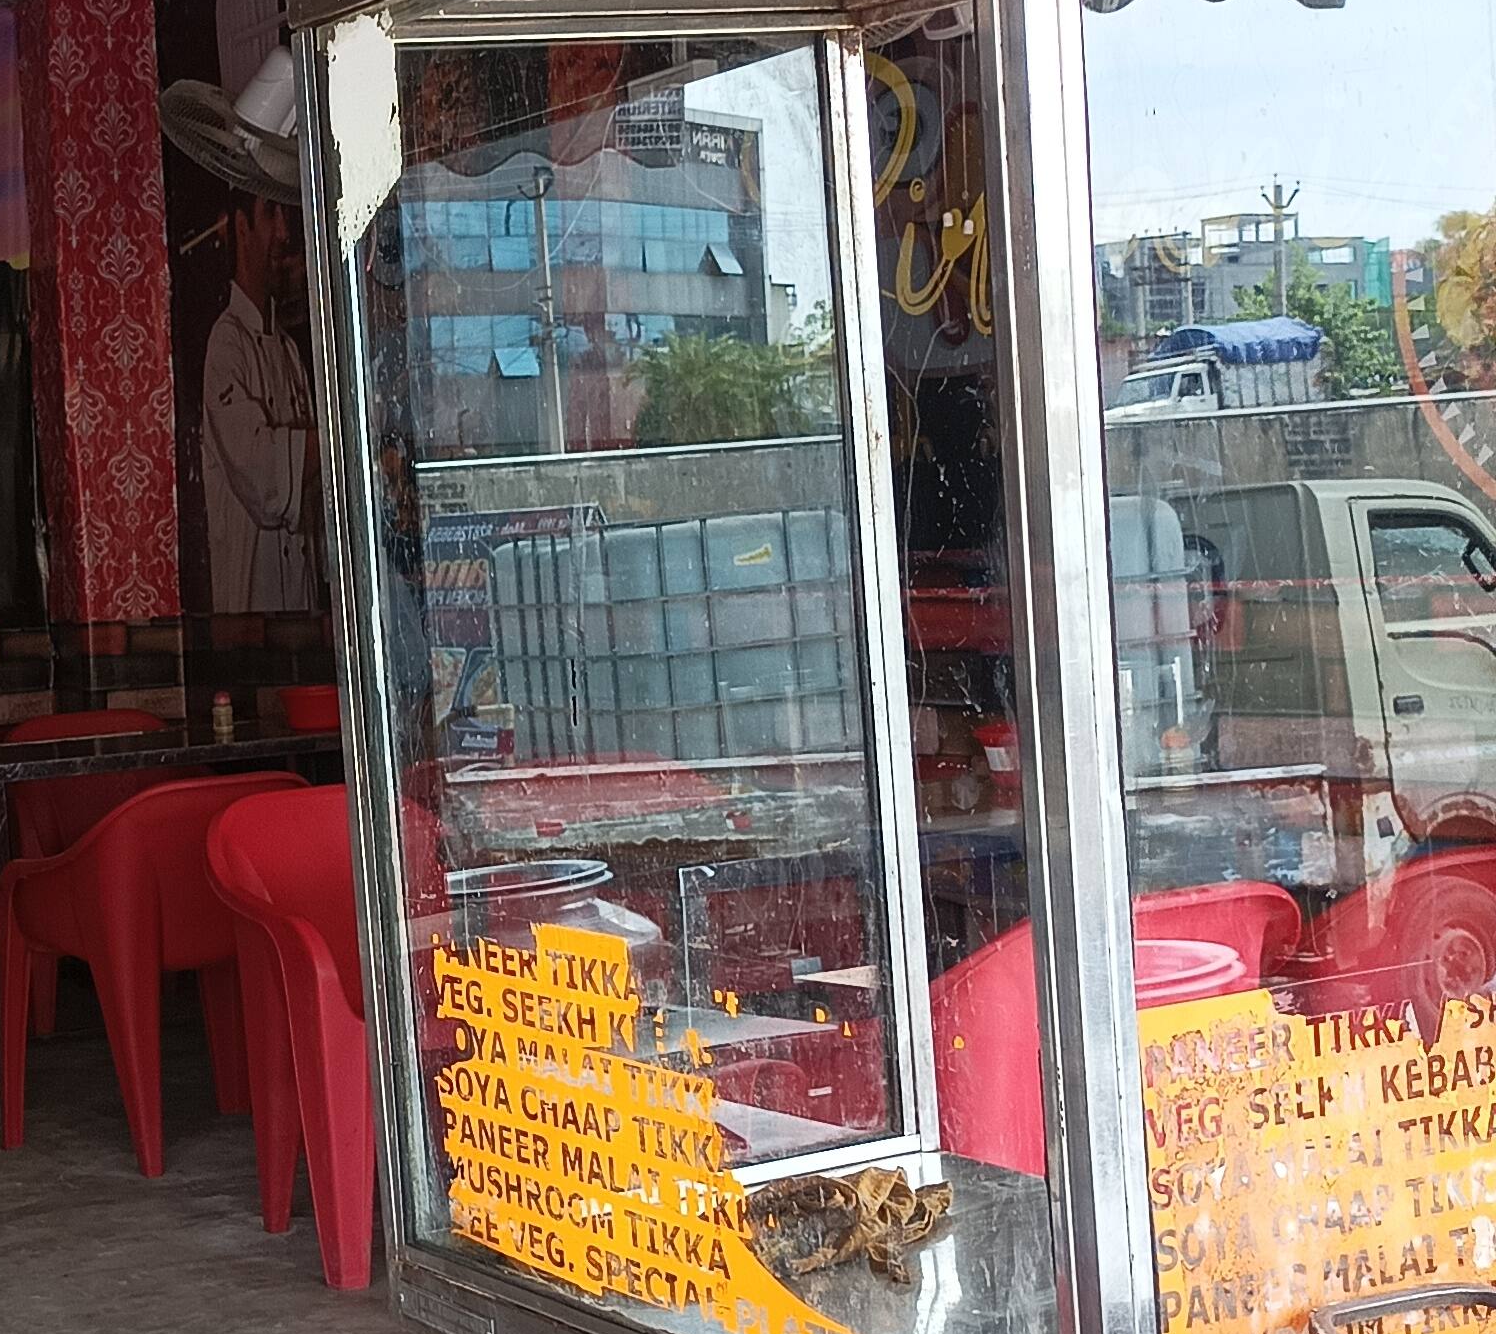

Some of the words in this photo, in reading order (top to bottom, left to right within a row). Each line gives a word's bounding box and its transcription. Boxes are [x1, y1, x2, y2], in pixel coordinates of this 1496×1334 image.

[430, 931, 538, 982] ANEER
[501, 987, 598, 1043] SEEKH
[450, 1021, 508, 1065] OYA
[517, 1037, 614, 1097] MALAI
[440, 1066, 513, 1116] SOYA
[520, 1085, 622, 1143] CHAAP
[1145, 1097, 1224, 1150] VEG
[1381, 1045, 1496, 1105] KEBAB
[444, 1107, 550, 1171] PANEER
[562, 1141, 662, 1205] MALAI
[624, 1209, 732, 1281] TIKKA
